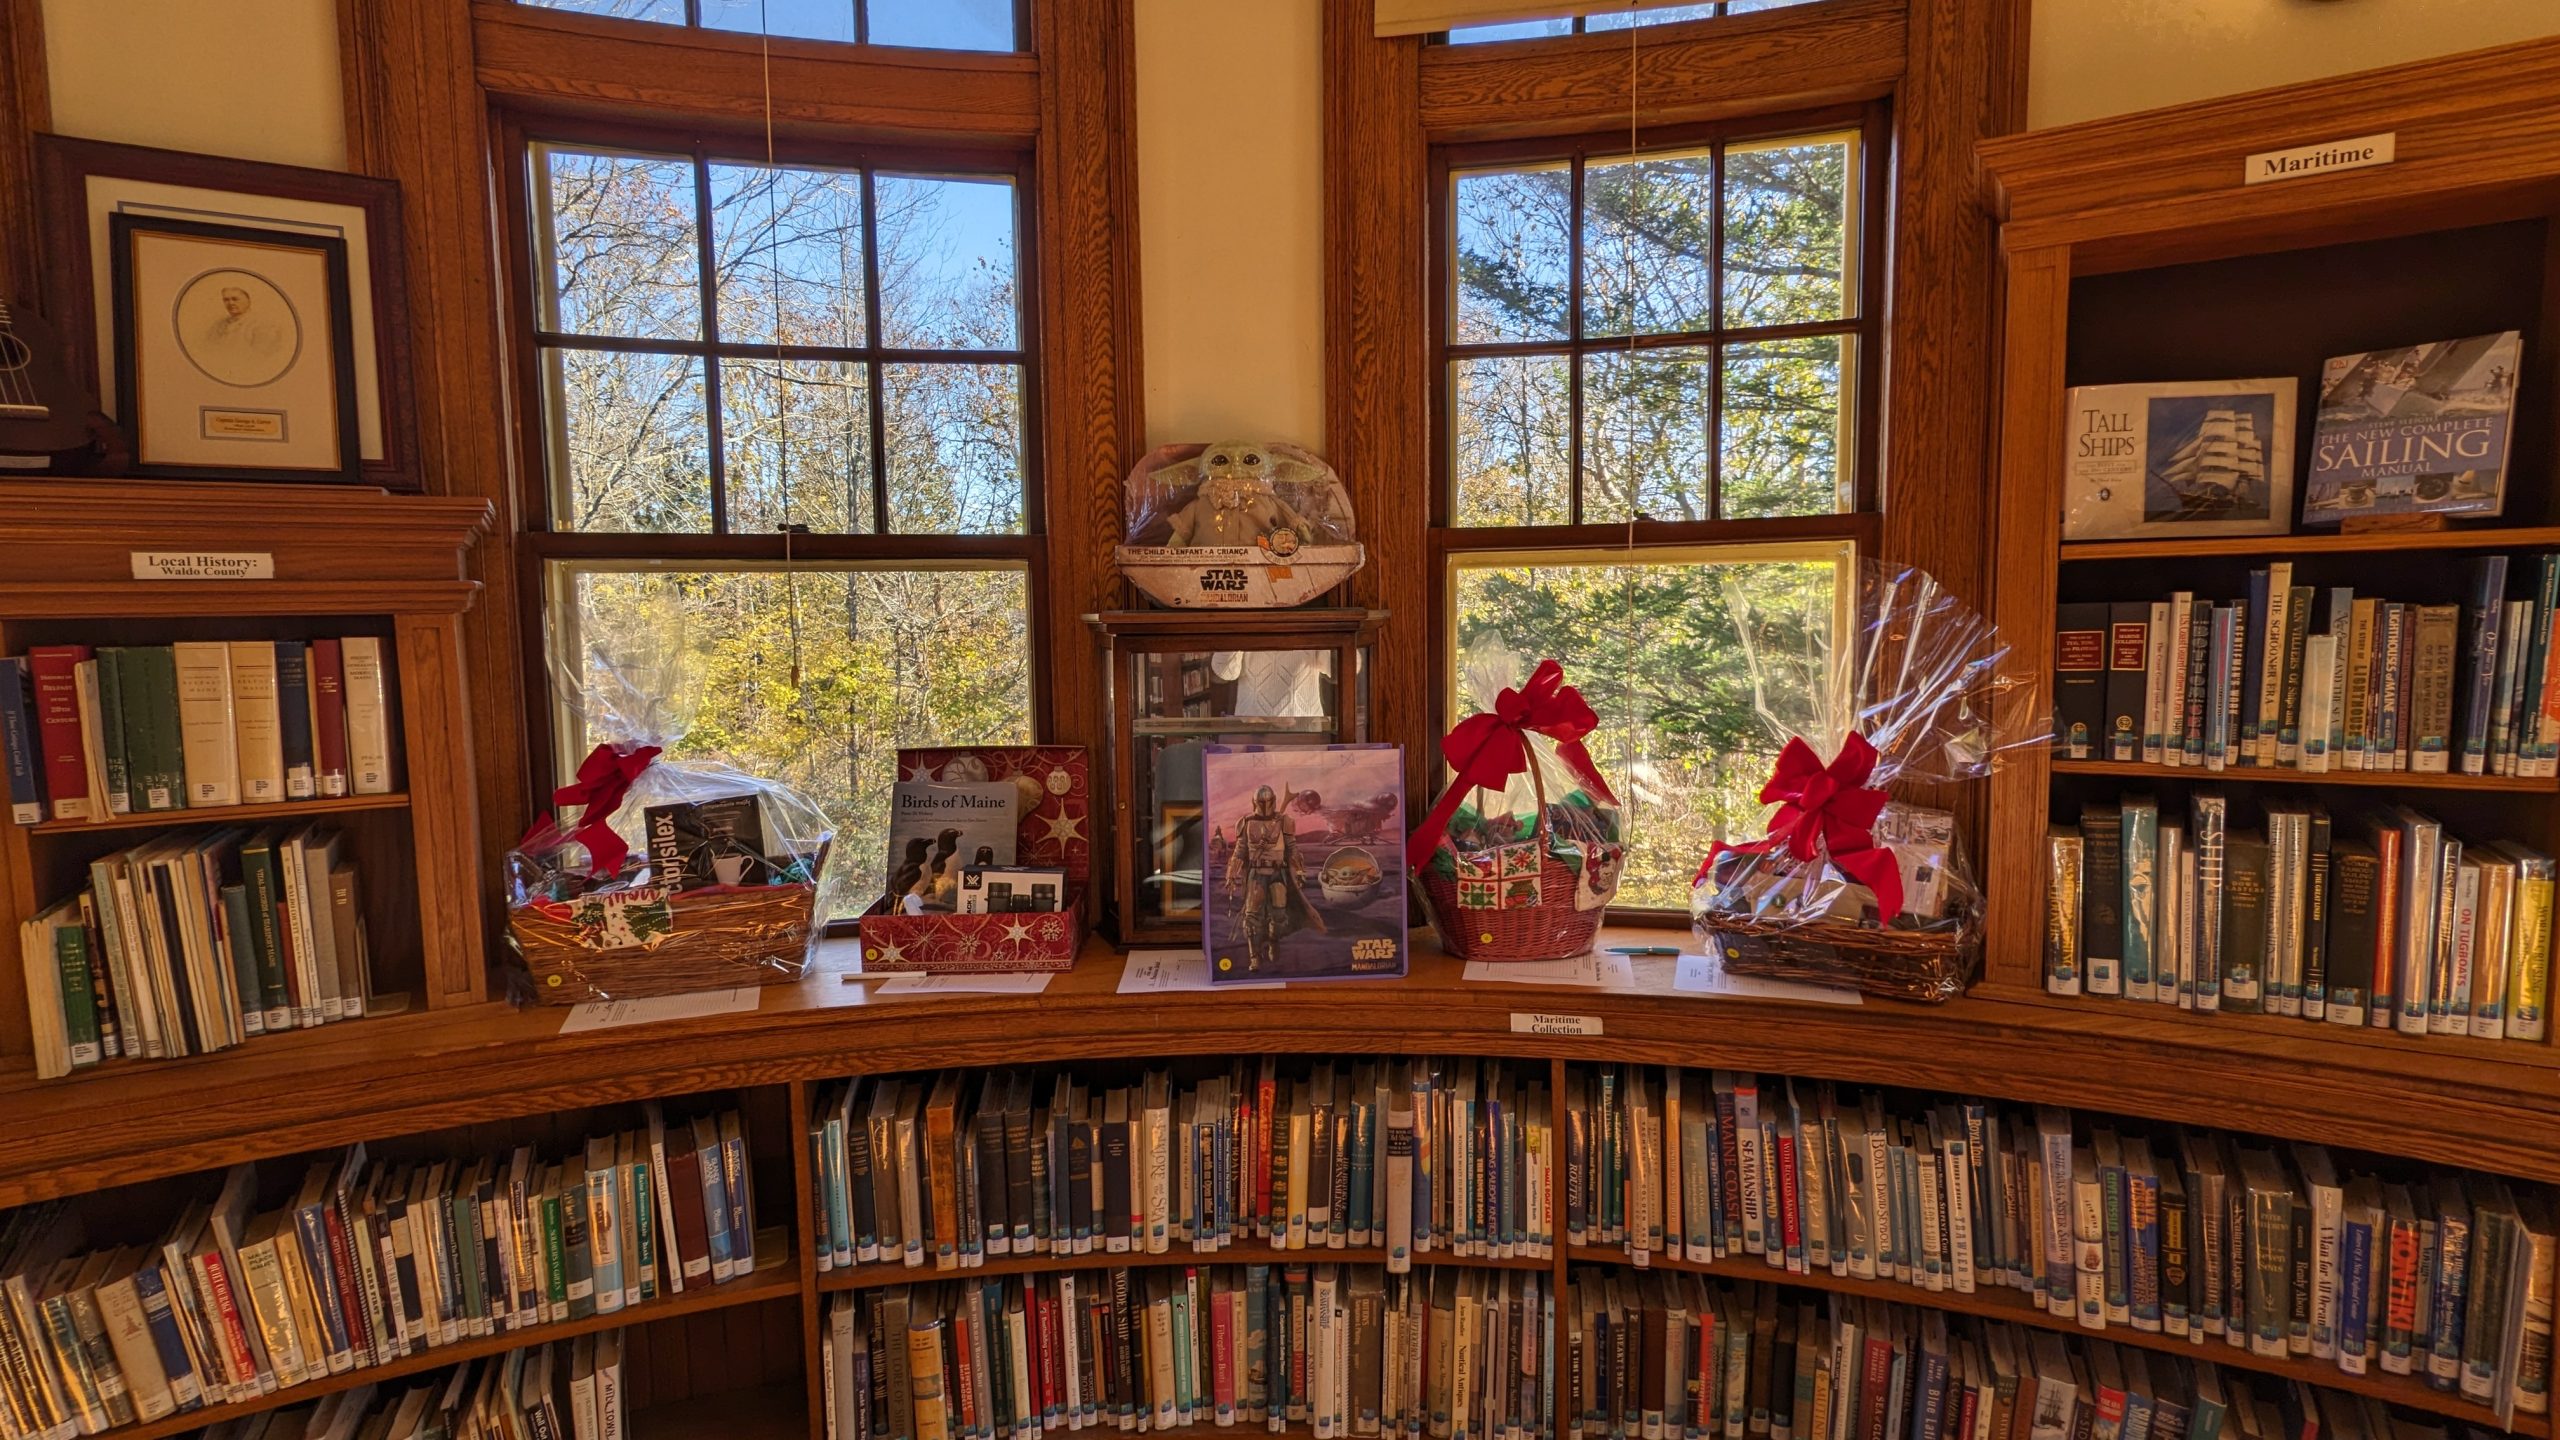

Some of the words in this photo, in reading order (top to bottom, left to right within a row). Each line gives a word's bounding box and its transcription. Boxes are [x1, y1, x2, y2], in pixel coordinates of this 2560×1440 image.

[2263, 147, 2374, 176] Maritime
[2082, 409, 2133, 433] TALL
[2320, 433, 2350, 445] THE
[2356, 428, 2395, 441] NEW
[2400, 417, 2494, 436] COMPLETE
[2078, 434, 2135, 458] SHIPS
[2316, 428, 2491, 472] SAILING
[2361, 462, 2432, 478] MANUAL
[148, 555, 191, 567] Local
[197, 555, 258, 569] History:
[1127, 547, 1142, 555] THE
[1143, 547, 1165, 555] CHILD
[1170, 547, 1203, 555] L'ENFANT
[1216, 547, 1248, 557] CRIANÇA
[161, 567, 201, 577] Waldo
[204, 567, 249, 578] County
[1200, 569, 1248, 580] STAR
[1200, 579, 1248, 591] WARS
[1200, 592, 1248, 603] MANDALORIAN
[2272, 592, 2283, 615] THE
[2267, 620, 2280, 677] SCHOONER
[2386, 609, 2400, 671] LIGHTHOUSES
[2386, 673, 2393, 682] of
[2435, 645, 2449, 731] LIGHTHOUSES
[2265, 683, 2276, 704] ERA
[2383, 682, 2396, 713] MAINE
[901, 794, 939, 809] Birds
[941, 794, 959, 809] of
[960, 795, 1006, 808] Maine
[2199, 831, 2224, 888] SHIP
[2314, 873, 2322, 884] THE
[257, 886, 269, 912] RECORDS
[2313, 902, 2321, 921] LINERS
[2460, 908, 2472, 925] ON
[262, 919, 274, 948] SEARSPORT
[1352, 938, 1396, 950] STAR
[267, 949, 276, 967] MAINE
[1351, 962, 1396, 971] MANDALORIAN
[1352, 948, 1396, 960] WARS
[2457, 929, 2471, 987] TUGBOATS
[1531, 1024, 1582, 1035] Collection
[1533, 1015, 1581, 1025] Maritime
[1720, 1115, 1736, 1166] MAINE
[1970, 1118, 1982, 1145] ROYAL
[1231, 1147, 1239, 1181] BOATS
[1763, 1142, 1776, 1189] SAILOR'S
[1782, 1142, 1793, 1162] WITH
[1871, 1139, 1886, 1179] BOATS
[1971, 1145, 1984, 1167] TOUR
[2054, 1151, 2066, 1169] SHE
[1711, 1152, 1719, 1186] Complete
[1742, 1140, 1758, 1220] SEAMANSHIP
[1783, 1164, 1793, 1198] RECKLESS
[2055, 1171, 2066, 1189] WAS
[1488, 1170, 1497, 1204] SAILBOAT
[1568, 1162, 1578, 1208] ROUTES
[1724, 1169, 1740, 1220] COAST
[1876, 1183, 1887, 1209] DAVID
[2106, 1172, 2118, 1194] CLIVE
[1712, 1189, 1720, 1210] Sailor
[1766, 1190, 1778, 1219] WIND
[2056, 1198, 2068, 1228] SISTER
[2131, 1179, 2145, 1230] CUSSLER
[2145, 1188, 2156, 1225] CLIVE
[1488, 1206, 1497, 1235] KINETICS
[1785, 1199, 1795, 1233] ABANDON
[2107, 1196, 2119, 1232] CUSSLER
[331, 1235, 341, 1254] NOTES
[550, 1229, 559, 1260] SOLDIERS
[1878, 1210, 1889, 1252] SEYBOLD
[2056, 1230, 2070, 1262] SAILOR
[2319, 1234, 2333, 1258] Man
[366, 1267, 376, 1289] HERE
[552, 1269, 561, 1291] GREEN
[2294, 1261, 2308, 1288] Ready
[2319, 1260, 2332, 1278] for
[2387, 1227, 2420, 1331] KON-TIKI
[1114, 1270, 1129, 1314] WOODEN
[2318, 1280, 2332, 1294] All
[370, 1292, 380, 1315] FIRST
[1320, 1289, 1328, 1329] SEAMANSHIP
[2294, 1290, 2308, 1317] About
[2318, 1295, 2331, 1327] Ocean
[1117, 1317, 1129, 1341] SHIP
[1293, 1297, 1303, 1351] CHAPMAN
[891, 1331, 901, 1352] THE
[1216, 1324, 1226, 1361] Fibreglass
[1511, 1346, 1519, 1354] of
[1616, 1334, 1624, 1364] HEART
[892, 1357, 902, 1387] LORE
[1217, 1363, 1226, 1383] Boats
[1307, 1353, 1315, 1385] KNOTS
[1458, 1345, 1467, 1375] Nautical
[1926, 1359, 1937, 1383] Horwitz
[1934, 1365, 1945, 1380] Tony
[964, 1363, 973, 1411] HISTORIC
[1294, 1352, 1303, 1396] PILOTIN
[1616, 1372, 1625, 1389] SEA
[858, 1389, 866, 1406] Yacht
[894, 1390, 903, 1405] OF
[1080, 1375, 1090, 1403] BOATS
[1457, 1376, 1467, 1408] Antiques
[1926, 1389, 1940, 1414] Blue
[534, 1409, 545, 1425] Well
[1510, 1389, 1518, 1418] Sailorme
[1815, 1385, 1826, 1439] MUTINY
[605, 1409, 616, 1437] TOWN
[859, 1408, 867, 1429] Design
[894, 1409, 905, 1439] SHIPS
[539, 1426, 549, 1440] Out
